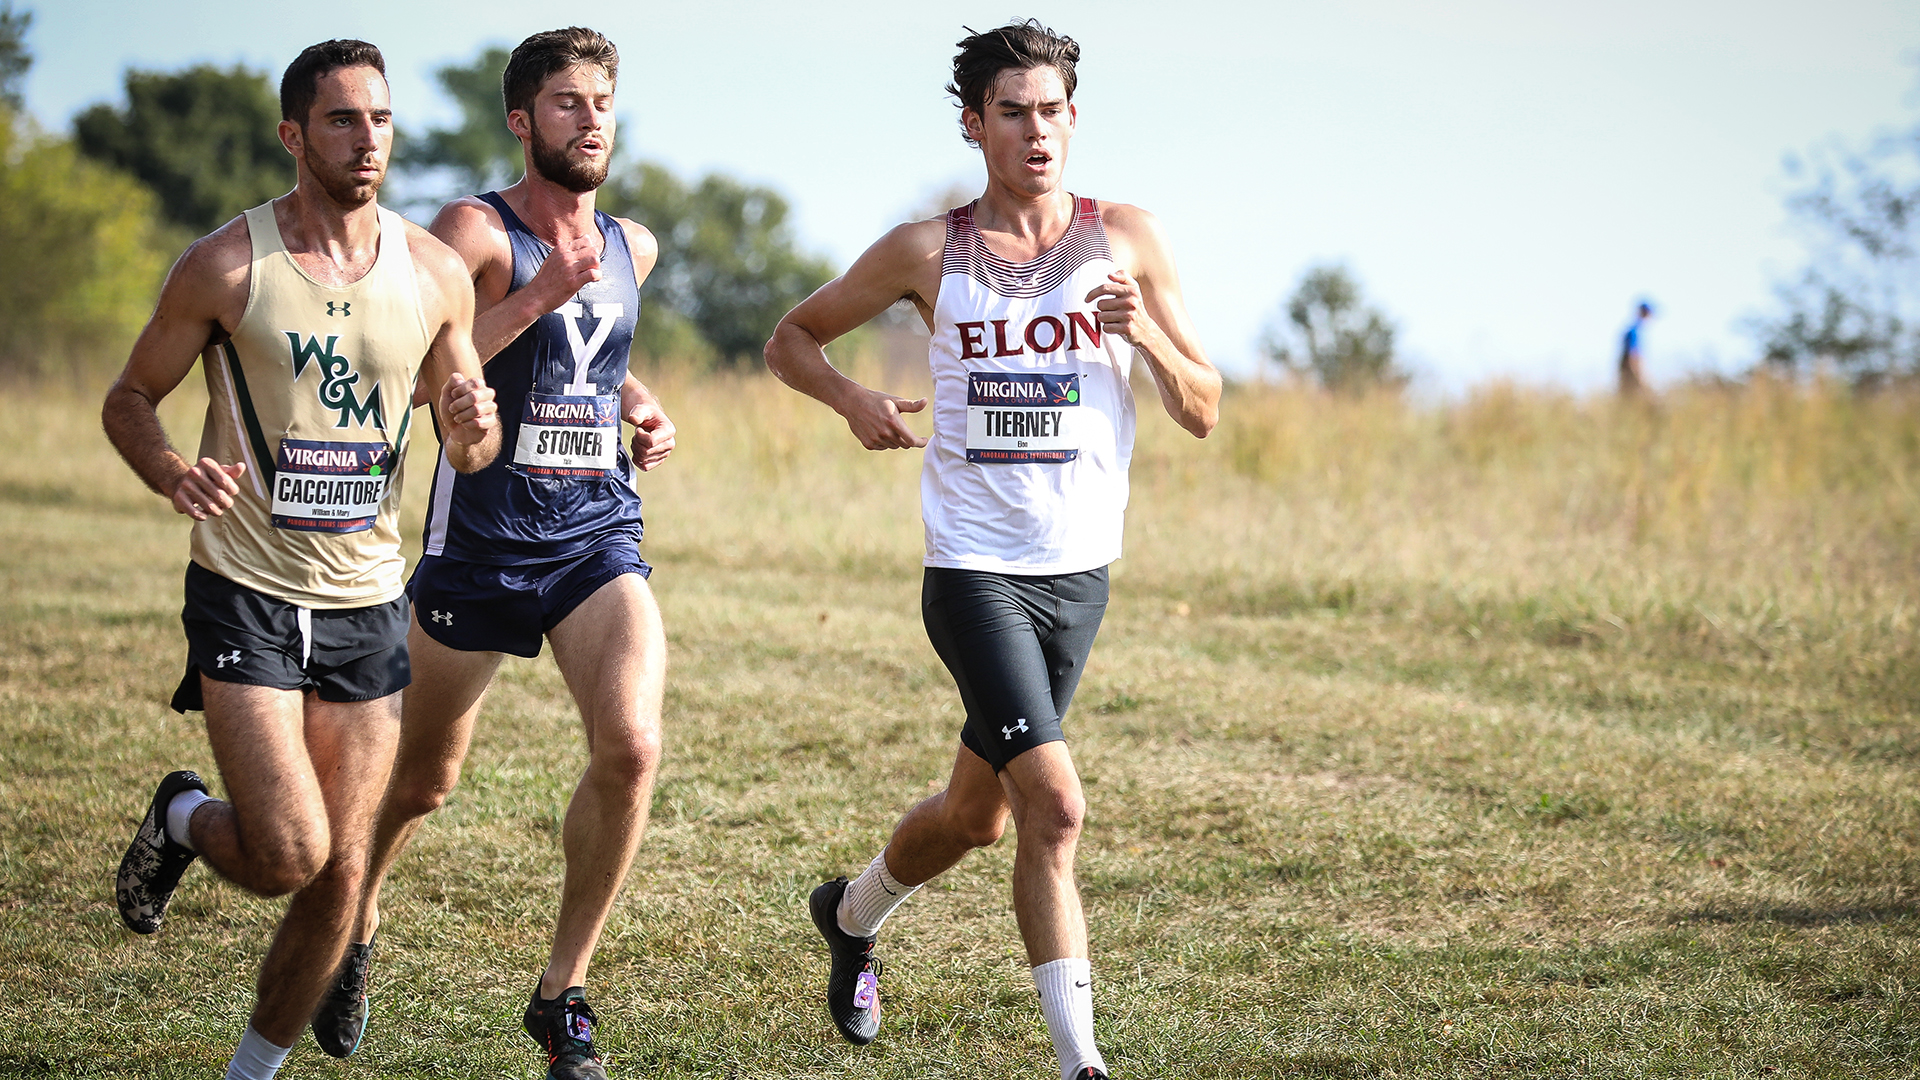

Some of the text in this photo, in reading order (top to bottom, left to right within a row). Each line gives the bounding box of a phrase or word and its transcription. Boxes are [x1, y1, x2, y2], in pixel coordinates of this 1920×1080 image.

[954, 311, 1101, 361] ELON
[553, 302, 624, 396] Y
[973, 381, 1047, 398] VIRGINIA
[529, 401, 595, 420] VIRGINIA
[984, 411, 1062, 437] TIERNEY
[536, 430, 603, 457] STONER
[1017, 440, 1028, 448] Elon
[284, 448, 358, 467] VIRGINIA
[980, 451, 1009, 459] PANORAMA
[1029, 450, 1066, 459] INVITATIONAL
[527, 466, 554, 475] PANORAMA
[571, 469, 605, 477] INVITATIONAL
[278, 478, 382, 505] CACCIATORE
[311, 508, 331, 516] William
[337, 509, 350, 517] Mary
[287, 518, 317, 527] PANORAMA
[318, 520, 336, 528] FARMS
